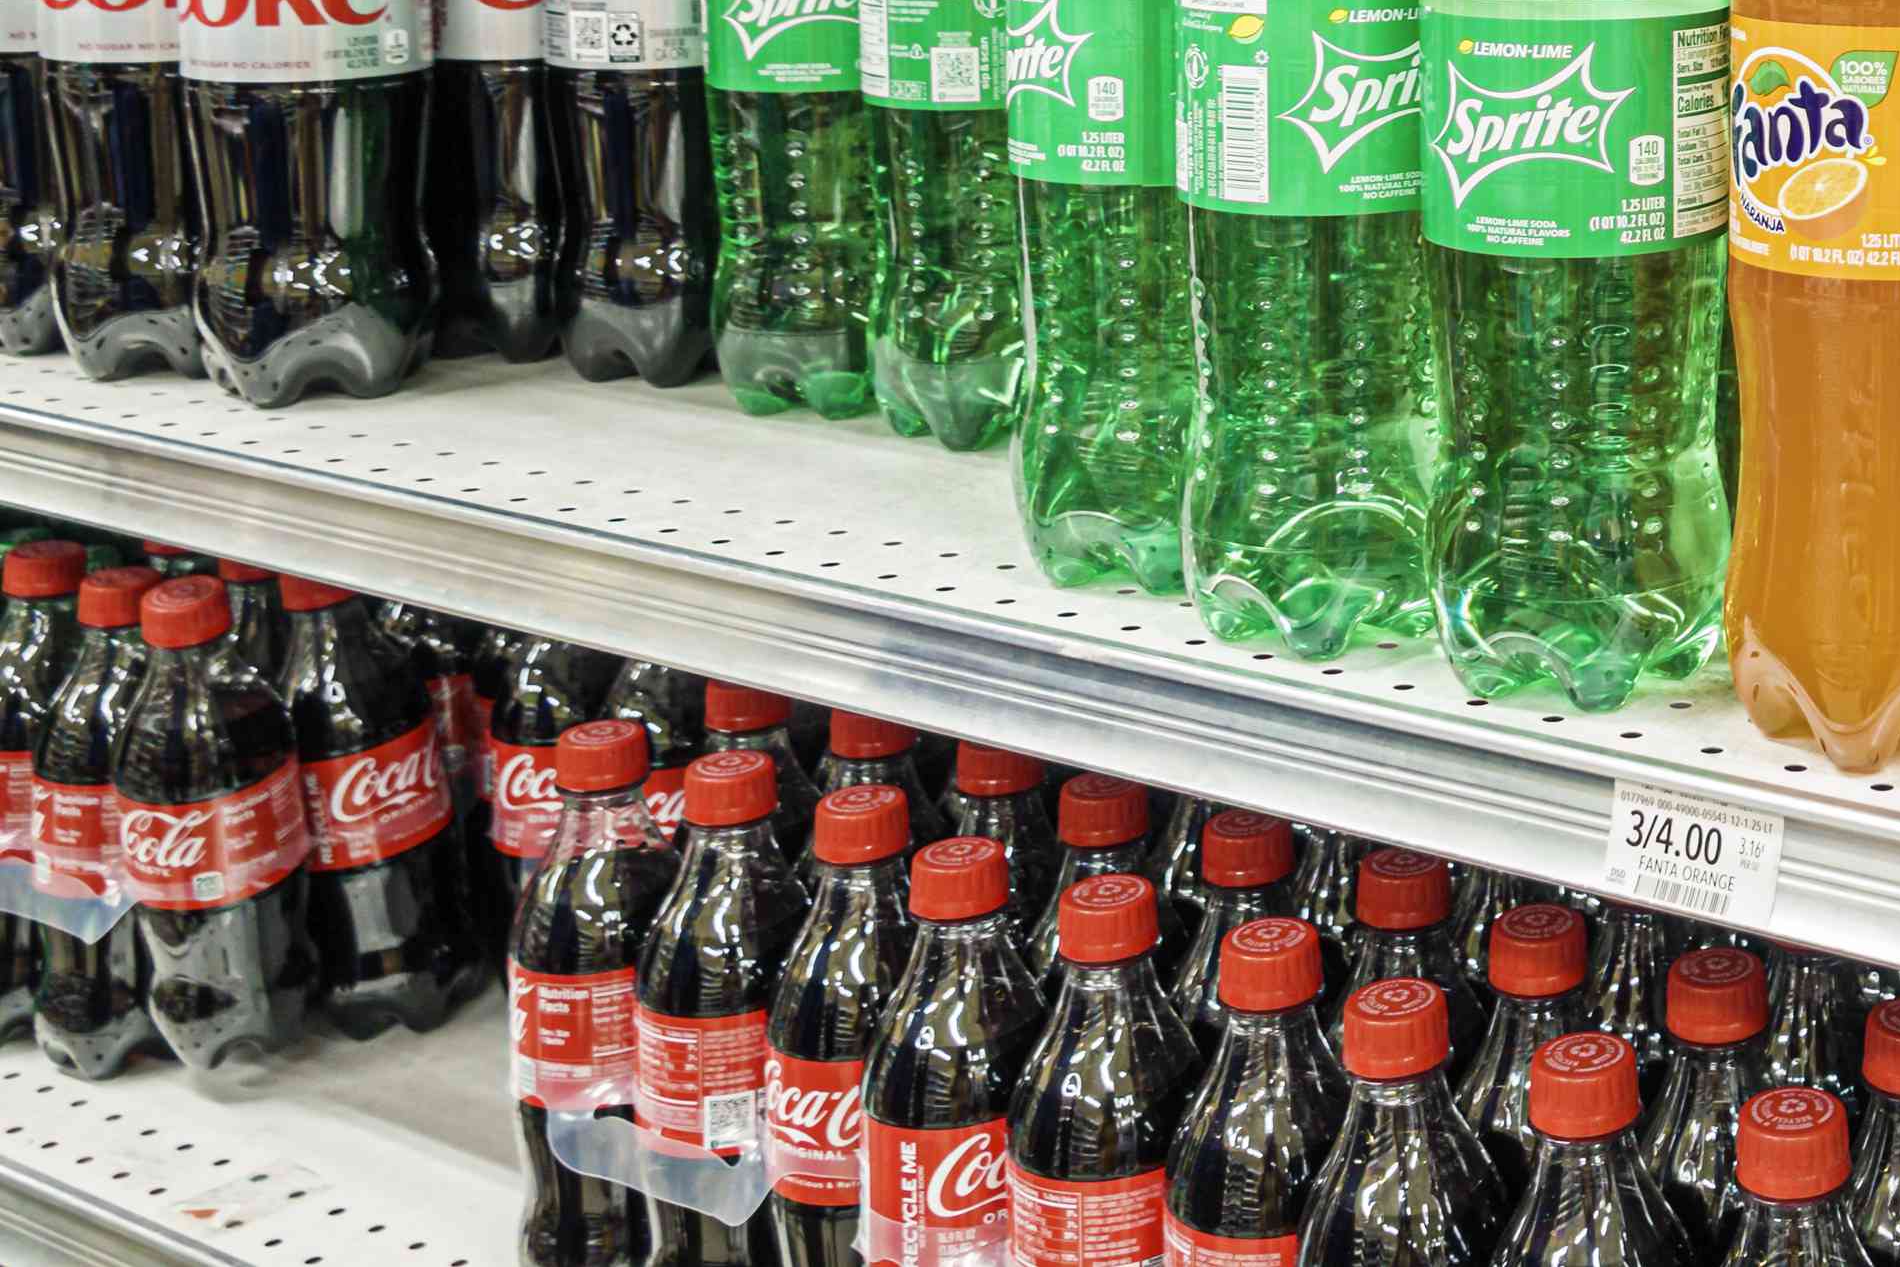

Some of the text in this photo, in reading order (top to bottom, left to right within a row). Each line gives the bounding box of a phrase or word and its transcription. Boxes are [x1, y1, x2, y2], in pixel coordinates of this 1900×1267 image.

[1349, 8, 1420, 23] LEMON-LI
[1677, 29, 1717, 47] Nutrition
[1473, 41, 1573, 59] LEMON-LIME
[1838, 61, 1888, 76] 100%
[1842, 75, 1886, 85] SABORES
[1095, 81, 1117, 96] 140
[1309, 58, 1422, 128] Spri
[1841, 85, 1888, 95] NATURALES
[1677, 93, 1715, 113] Calories
[1446, 94, 1601, 164] Sprite
[1637, 141, 1659, 156] 140
[1621, 197, 1666, 211] 1.25 LITER
[1740, 193, 1786, 233] NARANJA
[1476, 216, 1557, 229] LEMON-LIME SODA
[1487, 225, 1571, 238] NATURAL FLAVORS
[1487, 234, 1544, 247] NO CAFFEINE
[1763, 821, 1773, 833] LT
[1625, 809, 1722, 865] 3/4.00
[1639, 855, 1736, 892] FANTA ORANGE
[764, 1059, 863, 1148] Coca-C
[901, 1141, 918, 1267] RECYCLE ME
